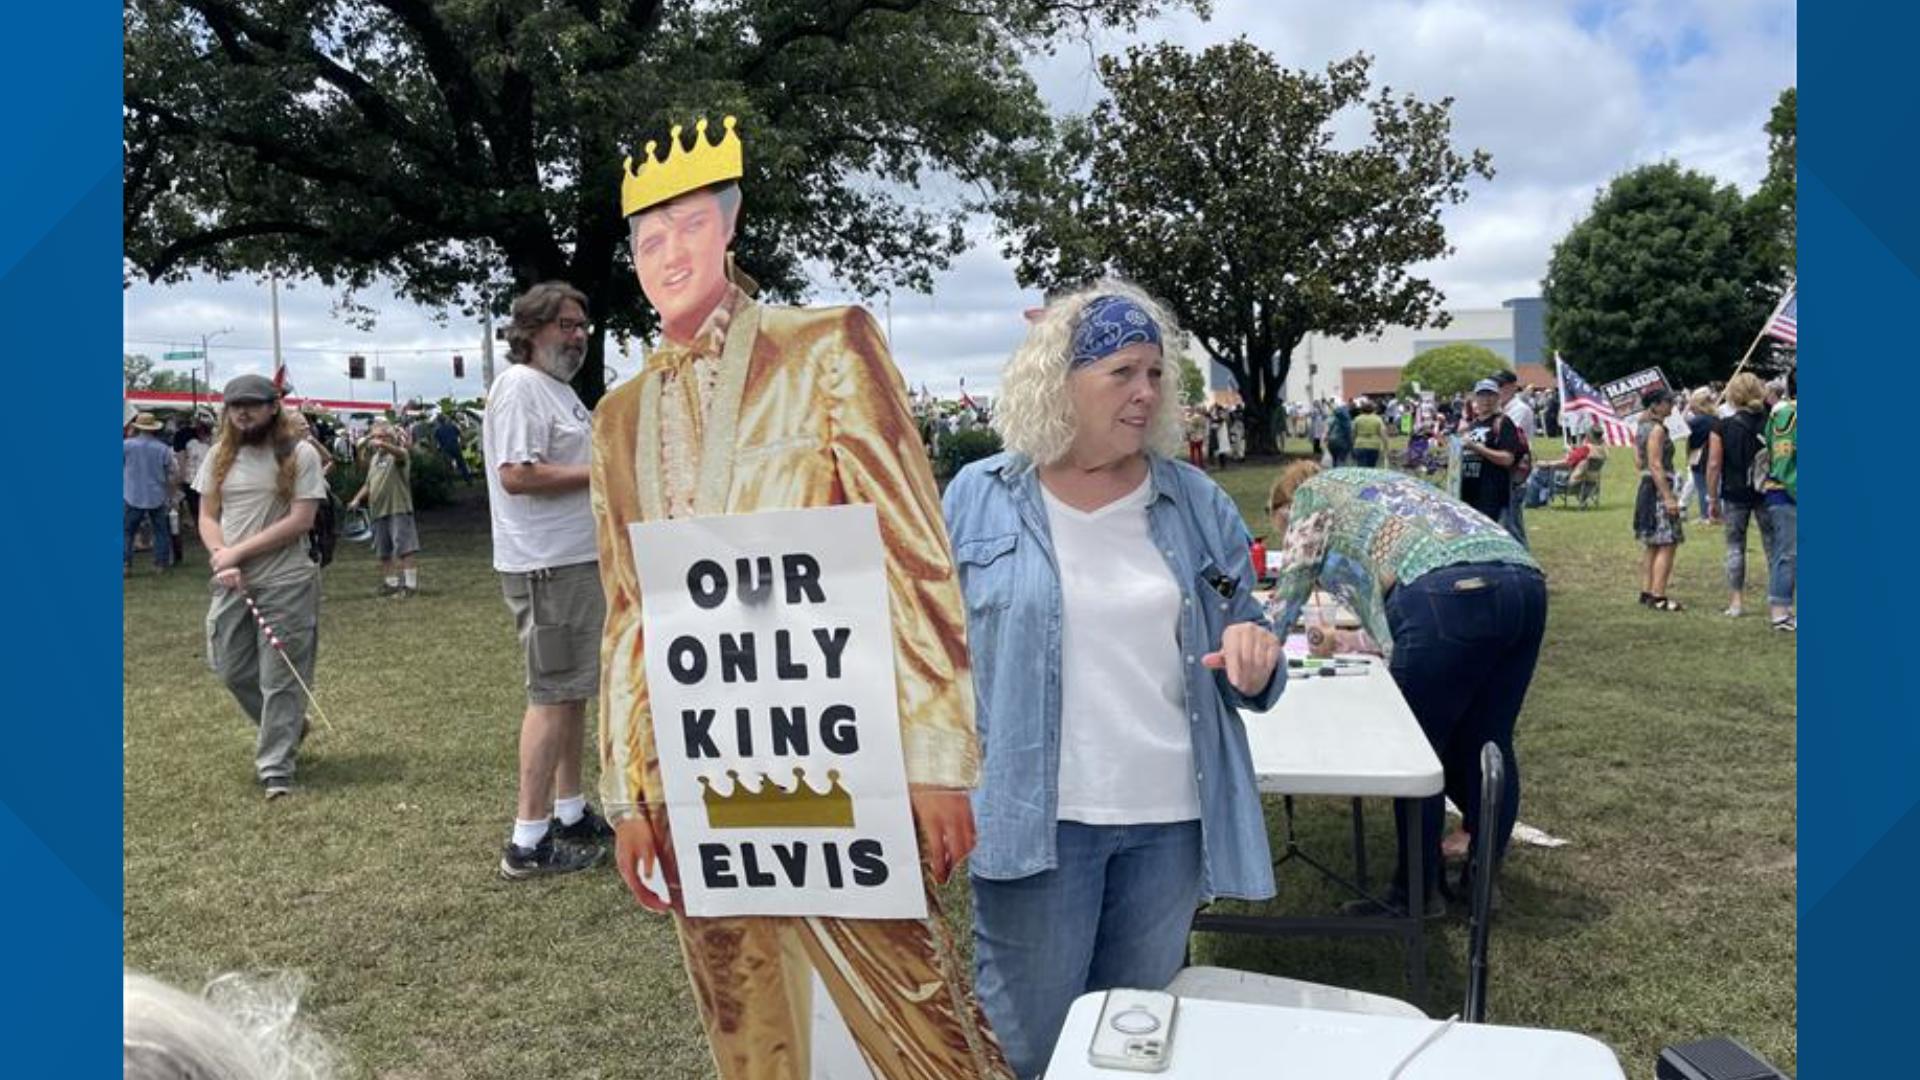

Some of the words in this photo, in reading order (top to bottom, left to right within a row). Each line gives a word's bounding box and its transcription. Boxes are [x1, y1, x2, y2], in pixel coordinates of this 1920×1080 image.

[686, 553, 826, 609] OUR
[667, 627, 851, 685] ONLY
[681, 704, 860, 759] KING
[698, 838, 889, 889] ELVIS
